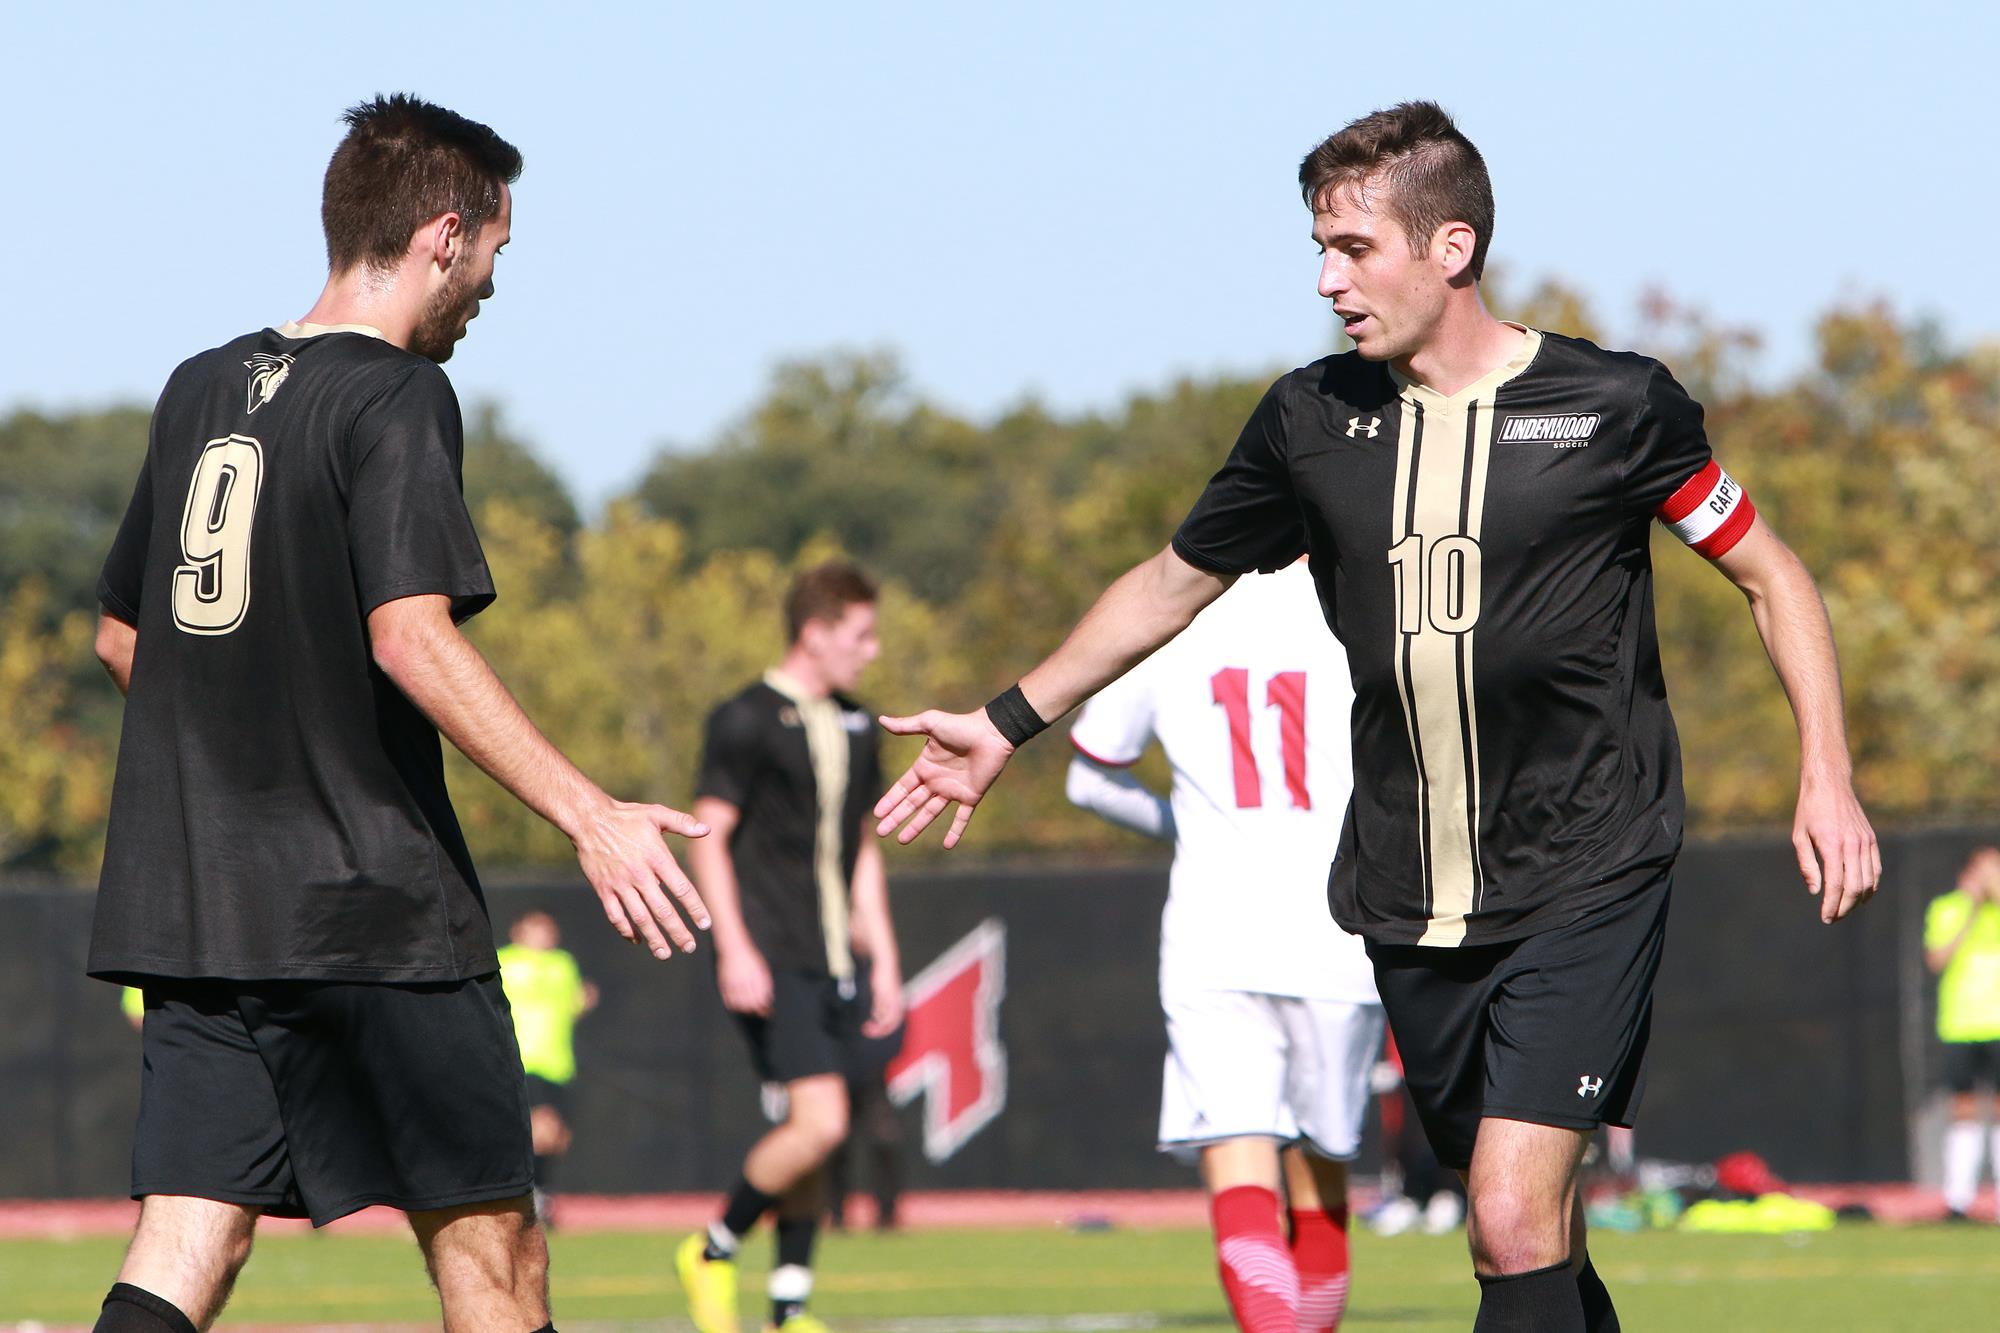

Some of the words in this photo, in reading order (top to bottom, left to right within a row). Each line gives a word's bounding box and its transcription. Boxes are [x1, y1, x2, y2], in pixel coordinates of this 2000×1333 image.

[1502, 416, 1597, 440] LINDENWOOD
[171, 434, 264, 636] 9
[1709, 474, 1737, 515] CAPT
[1387, 533, 1482, 635] 10
[1211, 667, 1311, 811] 11
